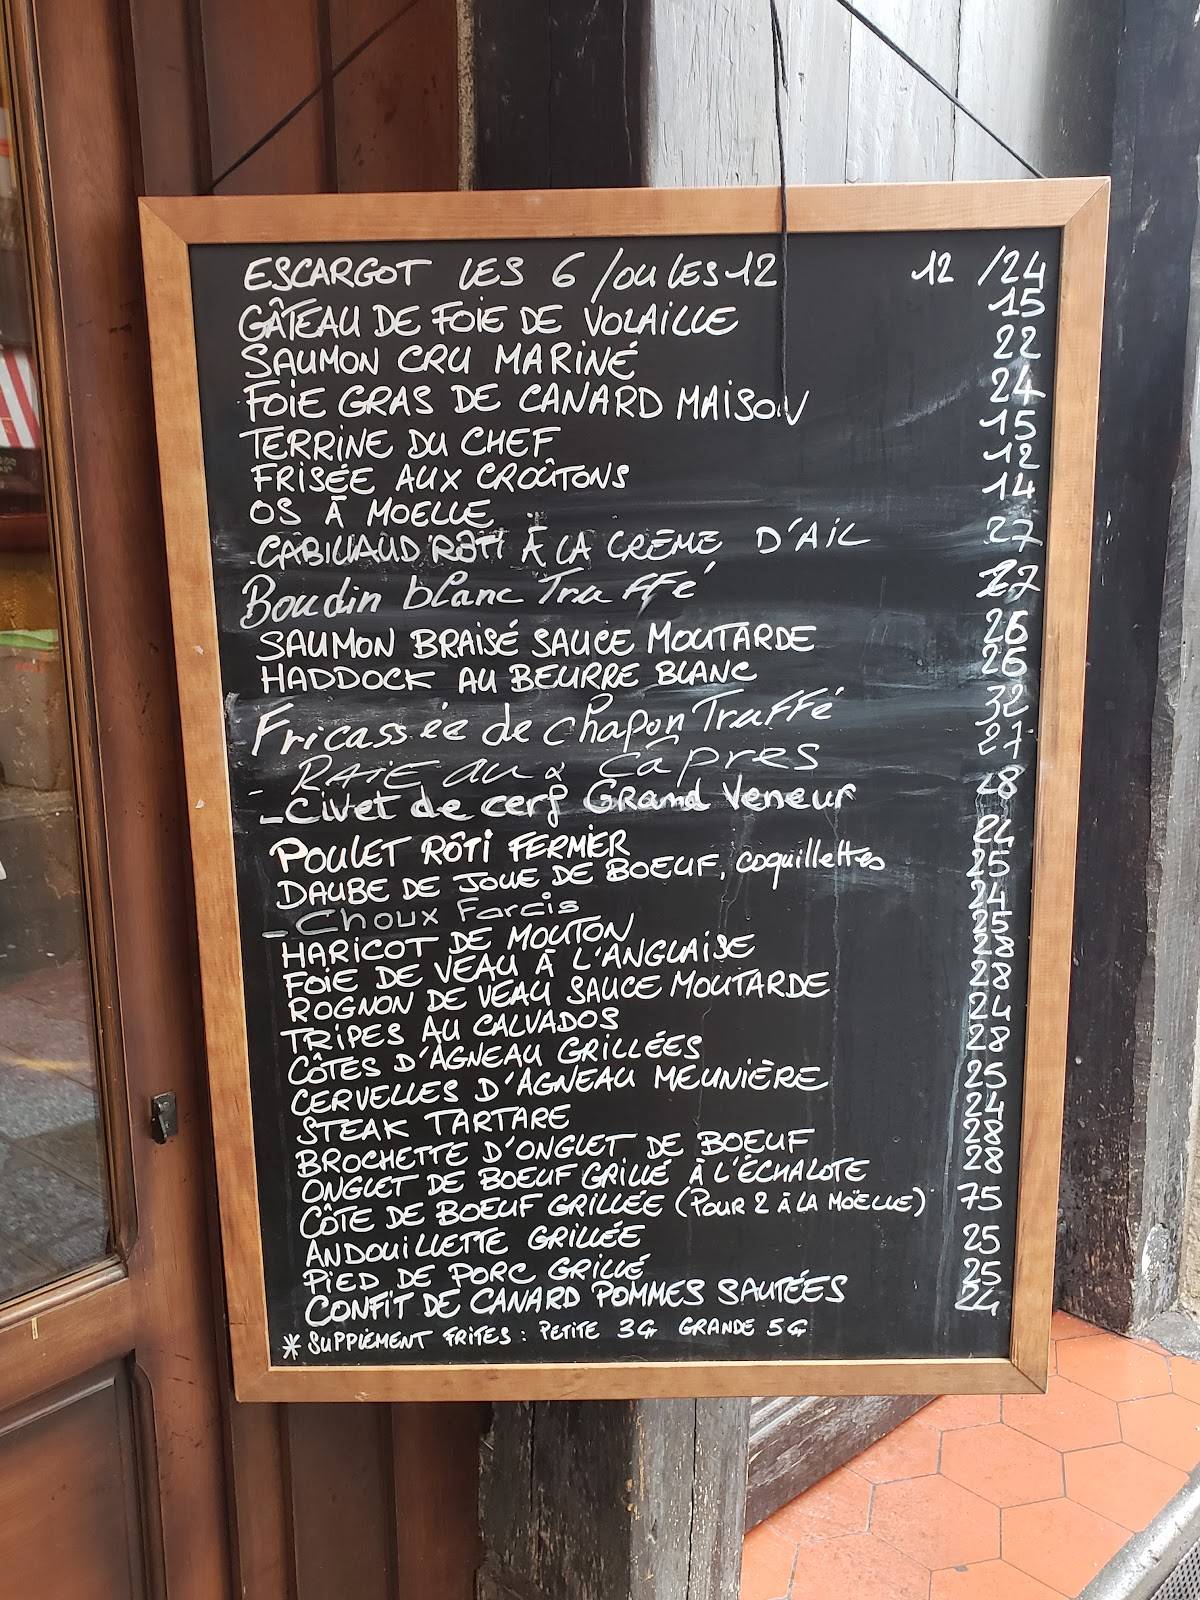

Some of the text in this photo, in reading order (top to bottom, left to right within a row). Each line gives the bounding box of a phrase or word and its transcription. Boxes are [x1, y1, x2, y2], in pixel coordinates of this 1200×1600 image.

[243, 256, 433, 292] ESCARGOT
[552, 251, 586, 289] 6
[722, 250, 779, 288] 12
[911, 249, 955, 286] 12
[238, 296, 739, 342] GÂTEAU DE FOIE DE VOLAILLE
[987, 286, 1046, 318] 15
[992, 323, 1042, 360] 22
[239, 339, 640, 382] SAUMON CRU MARINÉ
[242, 378, 810, 427] FOIE GRAS DE CANARD MAISON
[989, 364, 1047, 406] 24
[238, 424, 562, 462] TERRINE DU CHEF
[978, 409, 1038, 441] 15
[982, 441, 1041, 471] 12
[250, 459, 632, 496] FRISÉE AUX CROÛTONS
[981, 471, 1036, 501] 14
[249, 497, 302, 527] OS
[366, 497, 496, 530] MOELLE
[985, 515, 1044, 553] 27
[239, 572, 383, 630] Boudin
[402, 570, 526, 612] blanc
[255, 618, 817, 662] SAUMON BRAISÉ SAUCE MOUTARDE
[983, 607, 1030, 645] 26
[260, 658, 759, 695] HADDOCK AU BEURRE BLANC
[981, 643, 1029, 678] 26
[974, 683, 1031, 726] 32
[481, 702, 534, 747] de
[977, 720, 1024, 760] 27
[409, 785, 477, 822] de
[972, 813, 1016, 848] 24
[268, 834, 413, 875] POULET
[507, 824, 632, 864] FERMIER
[966, 848, 1011, 878] 25
[275, 877, 391, 910] DAUBE
[401, 876, 442, 901] DE
[451, 867, 541, 894] JOUE
[550, 861, 595, 886] DE
[968, 880, 1007, 911] 24
[295, 907, 441, 936] Choux
[971, 908, 1013, 935] 25
[281, 912, 636, 970] HARICOT DE MOUTON
[971, 932, 1016, 959] 28
[282, 967, 359, 999] FOIE
[374, 963, 424, 991] DE
[434, 952, 520, 984] VEAU
[968, 959, 1014, 992] 28
[287, 966, 832, 1024] ROGNON DE VEAU SAUCE MOUTARDE
[967, 991, 1013, 1022] 24
[280, 1006, 621, 1055] TRIPES AU CALVADOS
[964, 1022, 1012, 1054] 28
[287, 1030, 704, 1086] CÔTES D'AGNEAU GRILLÉES
[963, 1058, 1009, 1090] 25
[290, 1058, 829, 1117] CERVELLES D'AGNEAU MEUNIÈRE
[964, 1090, 1005, 1122] 24
[295, 1103, 572, 1147] STEAK TARTARE
[962, 1117, 1005, 1146] 28
[295, 1127, 817, 1179] BROCHETTE D'ONGLET DE BOEUF
[962, 1144, 1004, 1175] 28
[301, 1173, 421, 1204] ONGLET
[427, 1169, 467, 1198] DE
[477, 1162, 579, 1192] BOEUF
[580, 1155, 674, 1191] GRILLÉ
[956, 1182, 1004, 1212] 75
[299, 1204, 376, 1240] CÔTE
[385, 1201, 426, 1230] DE
[435, 1192, 544, 1227] BOEUF
[546, 1185, 666, 1219] GRILLÉE
[753, 1190, 770, 1216] 2
[304, 1220, 646, 1268] ANDOUILLETTE GRILLÉE
[962, 1222, 1002, 1256] 25
[302, 1252, 652, 1295] PIED DE PORC GRILLÉ
[962, 1257, 1003, 1287] 25
[303, 1268, 849, 1328] CONFIT DE CANARD POMMES SAUTÉES
[441, 1324, 513, 1348] FRITES
[538, 1319, 602, 1342] PETITE
[678, 1315, 756, 1338] GRANDE
